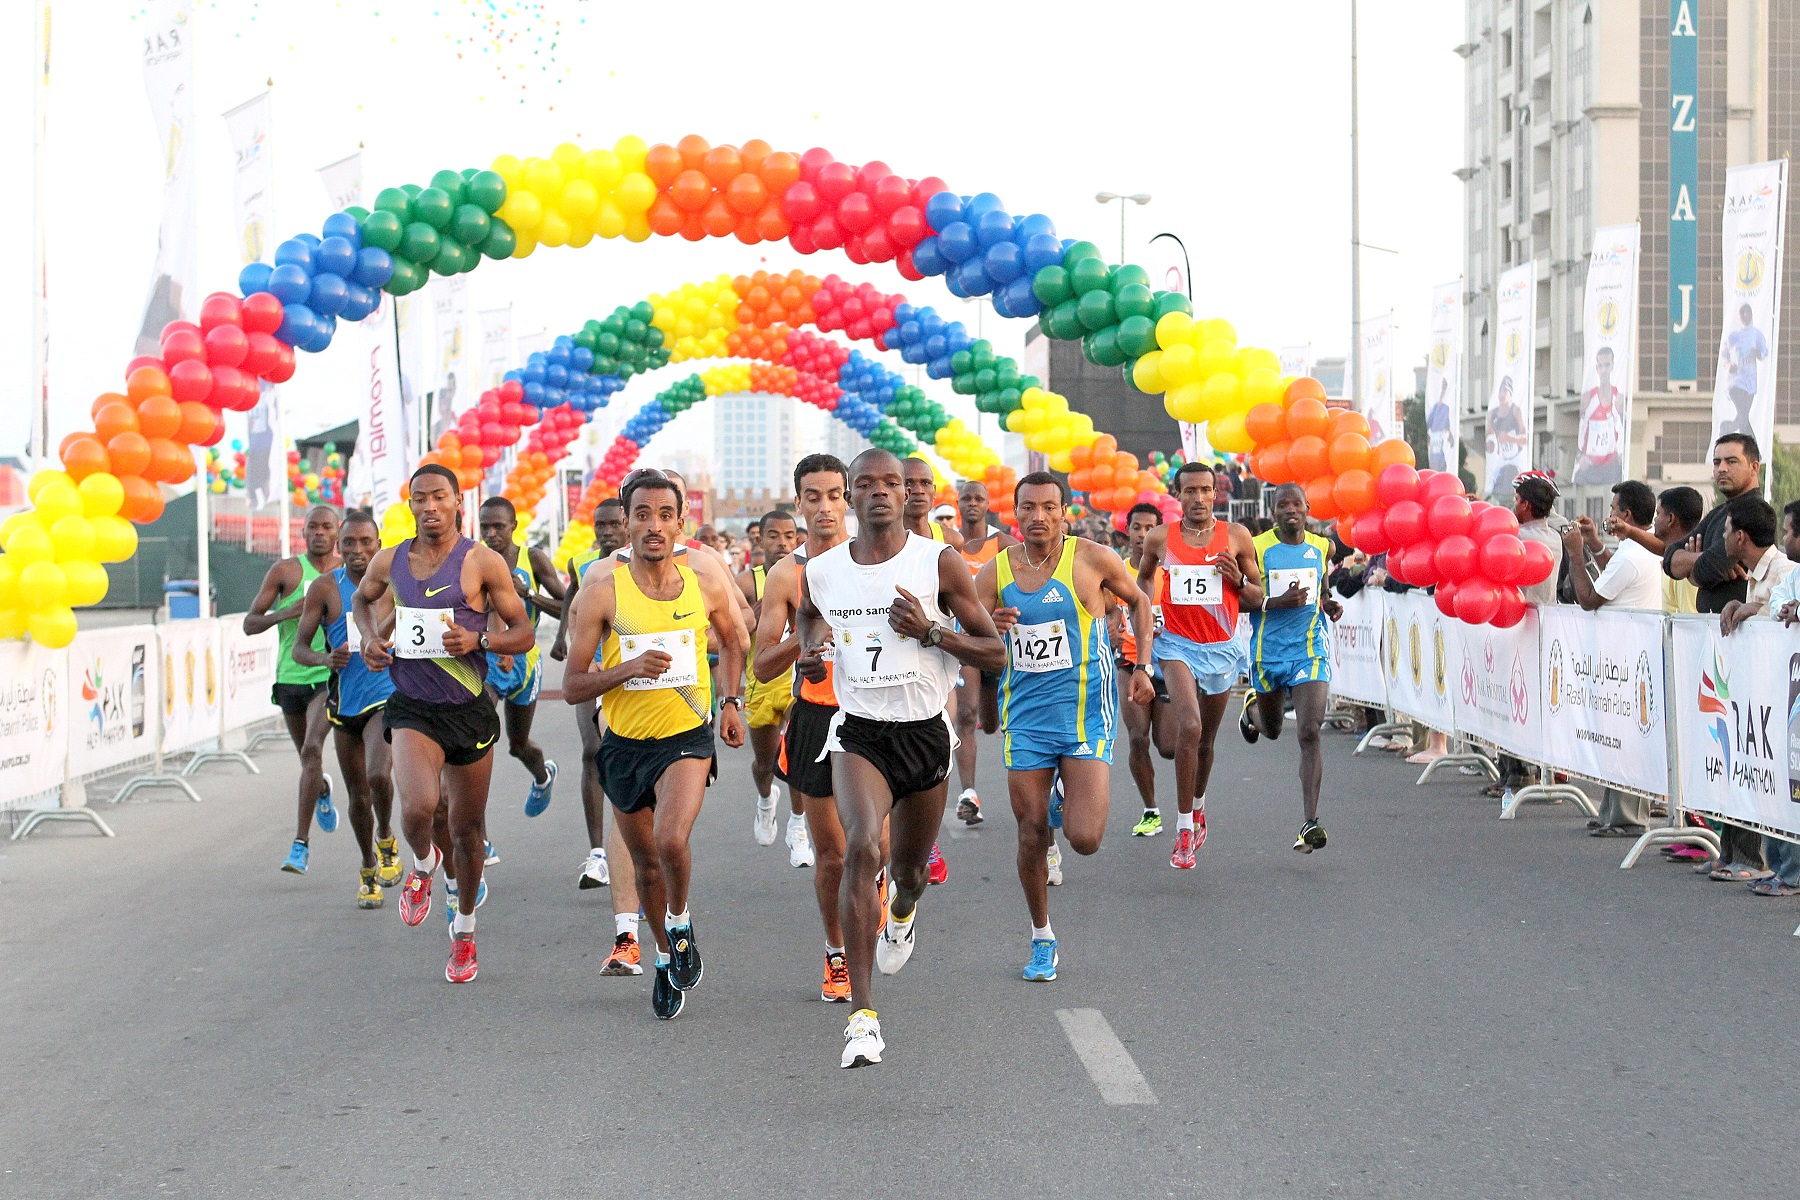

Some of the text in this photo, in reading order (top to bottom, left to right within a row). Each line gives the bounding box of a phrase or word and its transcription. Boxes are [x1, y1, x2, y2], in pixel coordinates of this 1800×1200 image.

[1183, 577, 1207, 595] 15
[829, 607, 863, 619] magno
[412, 625, 426, 647] 3
[866, 646, 882, 672] 7
[1014, 635, 1063, 661] 1427
[859, 675, 875, 684] HALF
[879, 670, 918, 683] MARATHON
[1731, 698, 1774, 761] RAK
